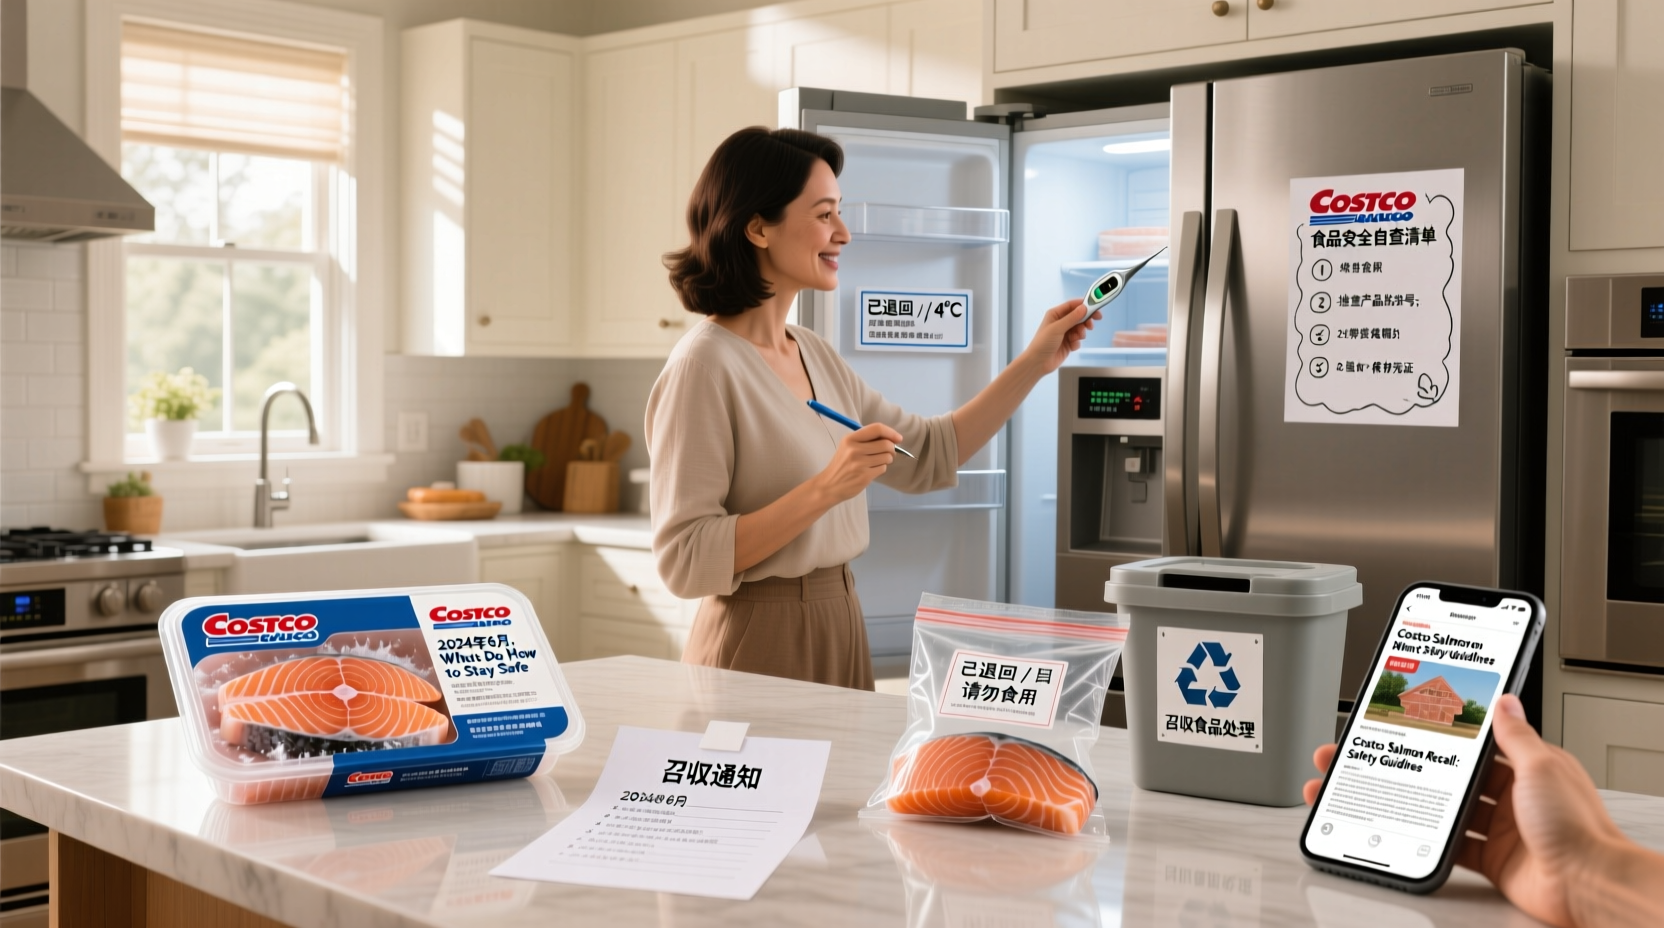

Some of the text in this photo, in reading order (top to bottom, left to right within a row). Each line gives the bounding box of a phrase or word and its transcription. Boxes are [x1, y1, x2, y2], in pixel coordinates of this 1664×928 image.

[445, 668, 461, 678] to
[464, 665, 494, 678] Stay
[962, 681, 1038, 706] 请勿食用
[1165, 714, 1255, 739] 召收食品处理
[662, 759, 762, 790] 召收通知
